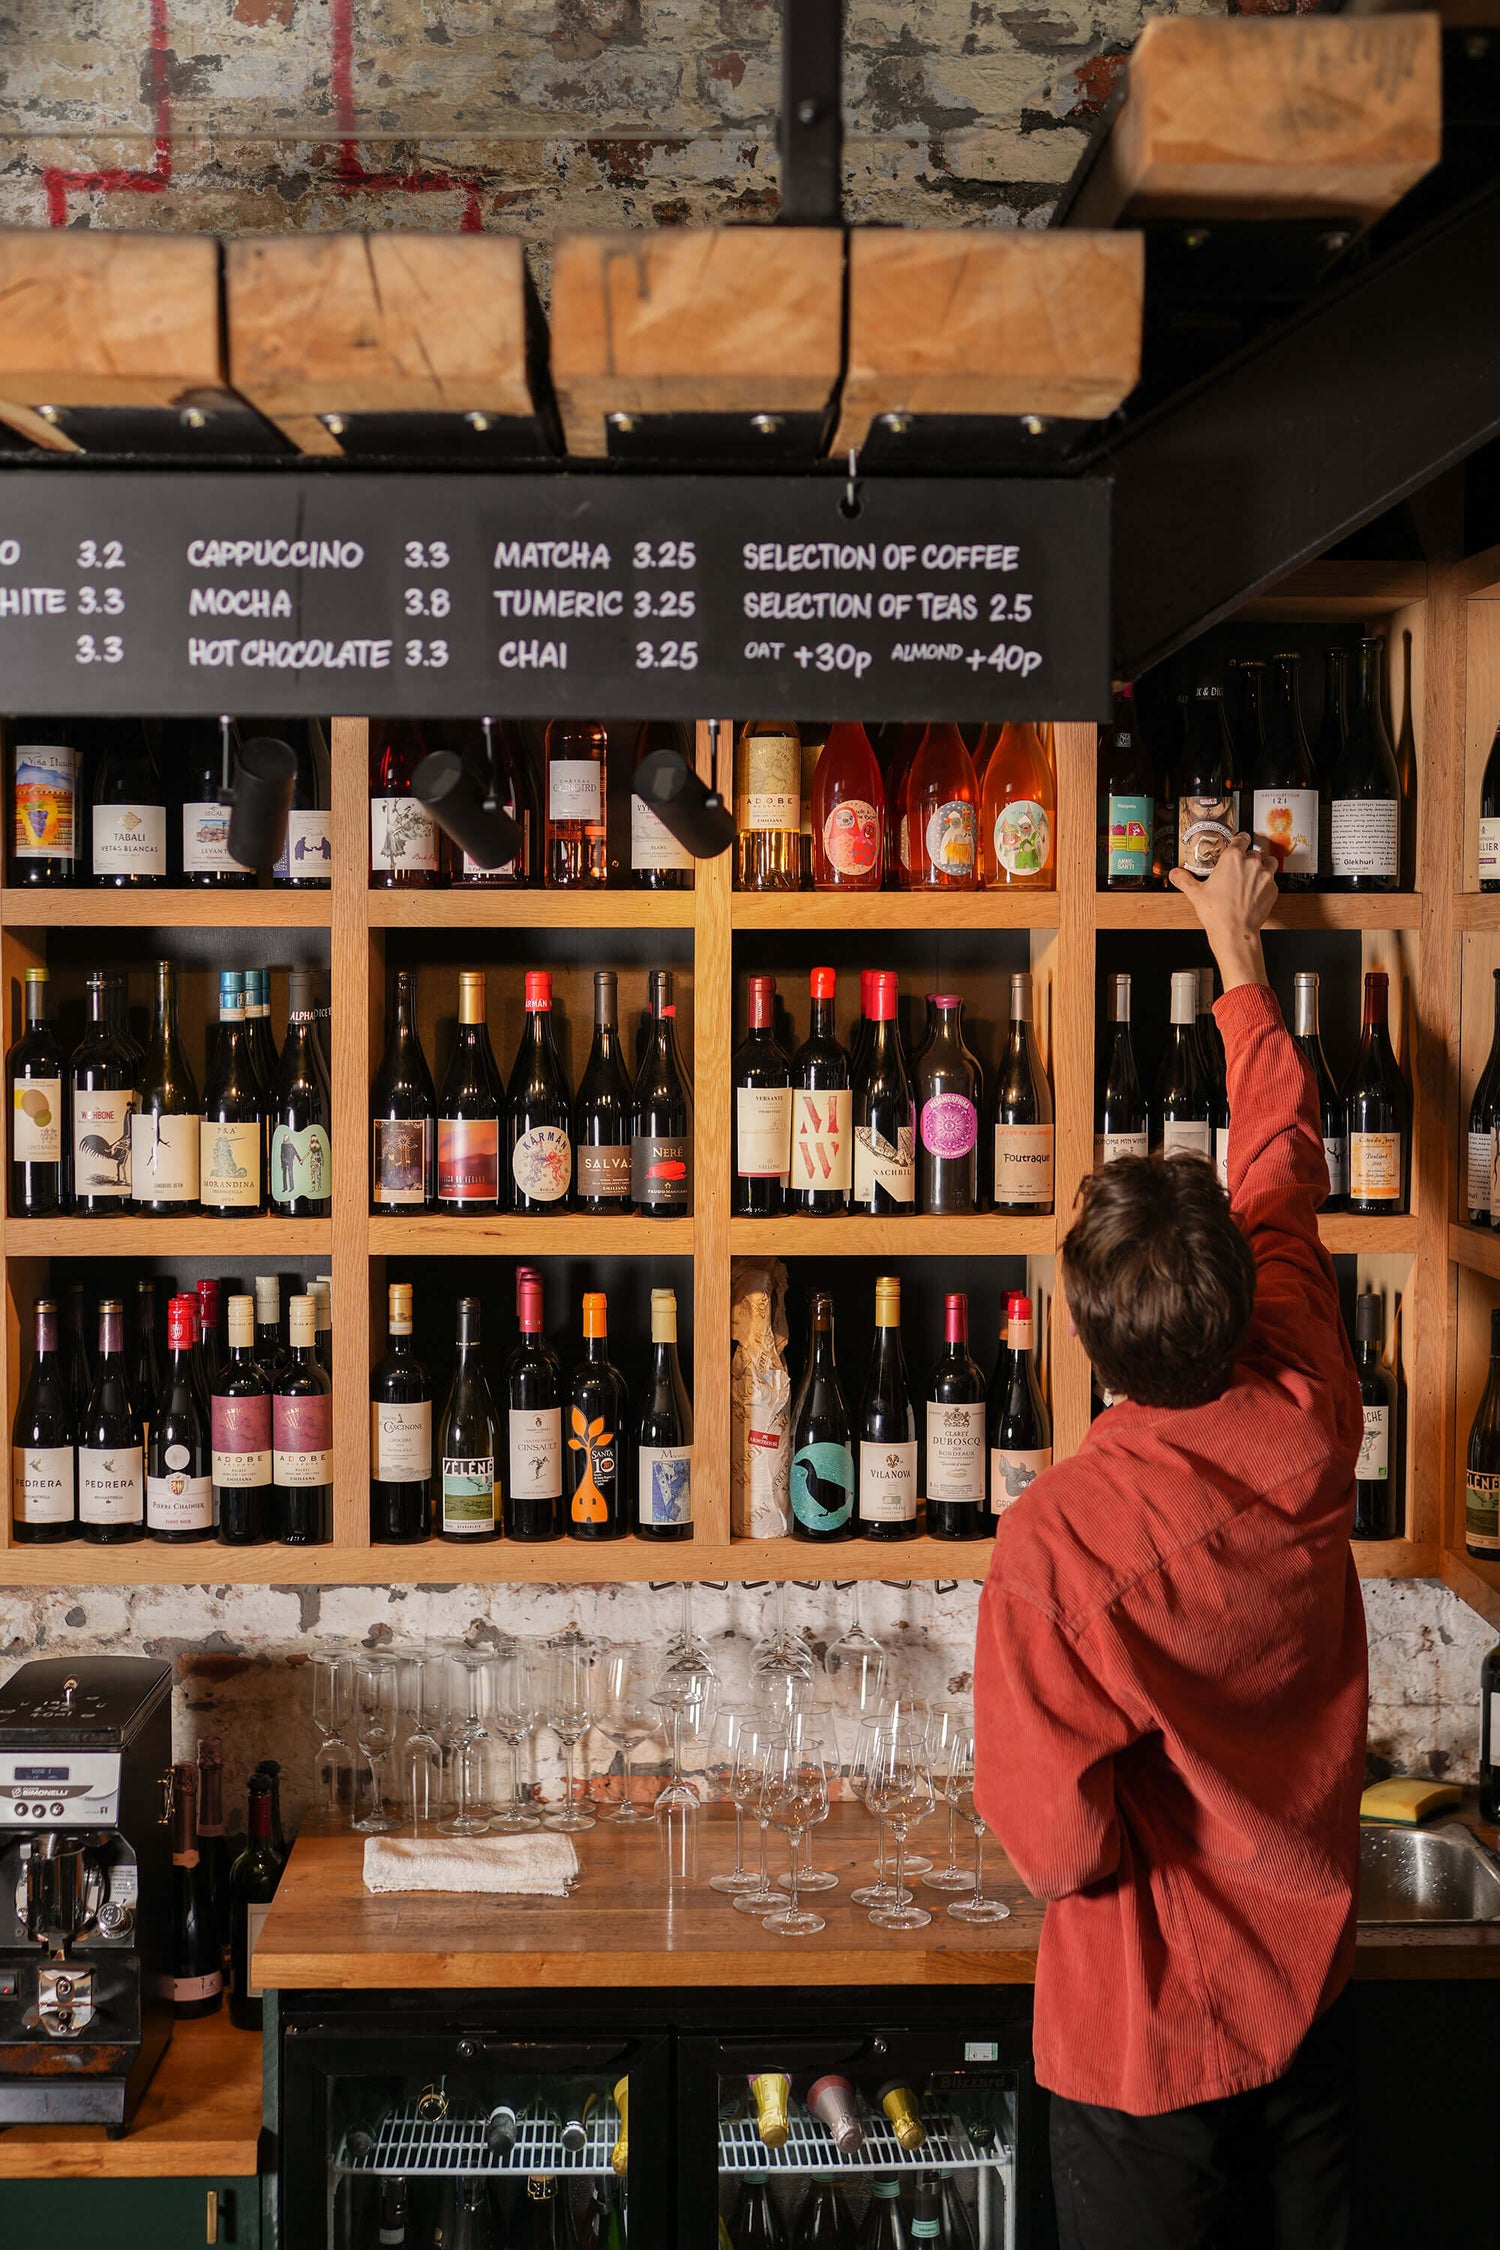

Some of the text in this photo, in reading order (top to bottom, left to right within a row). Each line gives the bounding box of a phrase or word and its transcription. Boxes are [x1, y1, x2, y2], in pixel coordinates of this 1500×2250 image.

[76, 539, 126, 570] 3.2
[187, 539, 450, 569] CAPPUCCINO 3.3
[494, 540, 696, 570] MATCHA 3.25
[743, 543, 1020, 572] SELECTION OF COFFEE
[77, 585, 126, 615] 3.3
[189, 587, 451, 619] MOCHA 3.8
[493, 589, 696, 619] TUMERIC 3.25
[743, 591, 1034, 623] SELECTION OF TEAS 2.5
[75, 633, 125, 665] 3.3
[187, 636, 450, 670] HOT CHOCOLATE 3.3
[498, 638, 699, 670] CHAI 3.25
[744, 640, 1043, 679] OAT +30p ALMOND +40p
[746, 797, 793, 805] ADOBE
[1343, 858, 1374, 866] Glekhuri
[289, 1010, 313, 1021] ALPHA
[799, 1095, 840, 1134] M
[522, 1131, 567, 1151] KÁRMÁN
[652, 1146, 684, 1158] NERÉ
[1003, 1153, 1051, 1164] Foutraque
[873, 1168, 912, 1177] NACHBIL
[203, 1180, 256, 1189] MORANDINA
[932, 1436, 981, 1447] DUBOSCQ
[217, 1454, 264, 1463] ADOBE
[279, 1454, 327, 1463] ADOBE
[591, 1449, 614, 1460] SANTA
[592, 1457, 615, 1474] 10
[15, 1479, 63, 1488] PEDRERA
[85, 1479, 135, 1489] PEDRERA
[22, 1789, 70, 1798] SIMONELLI
